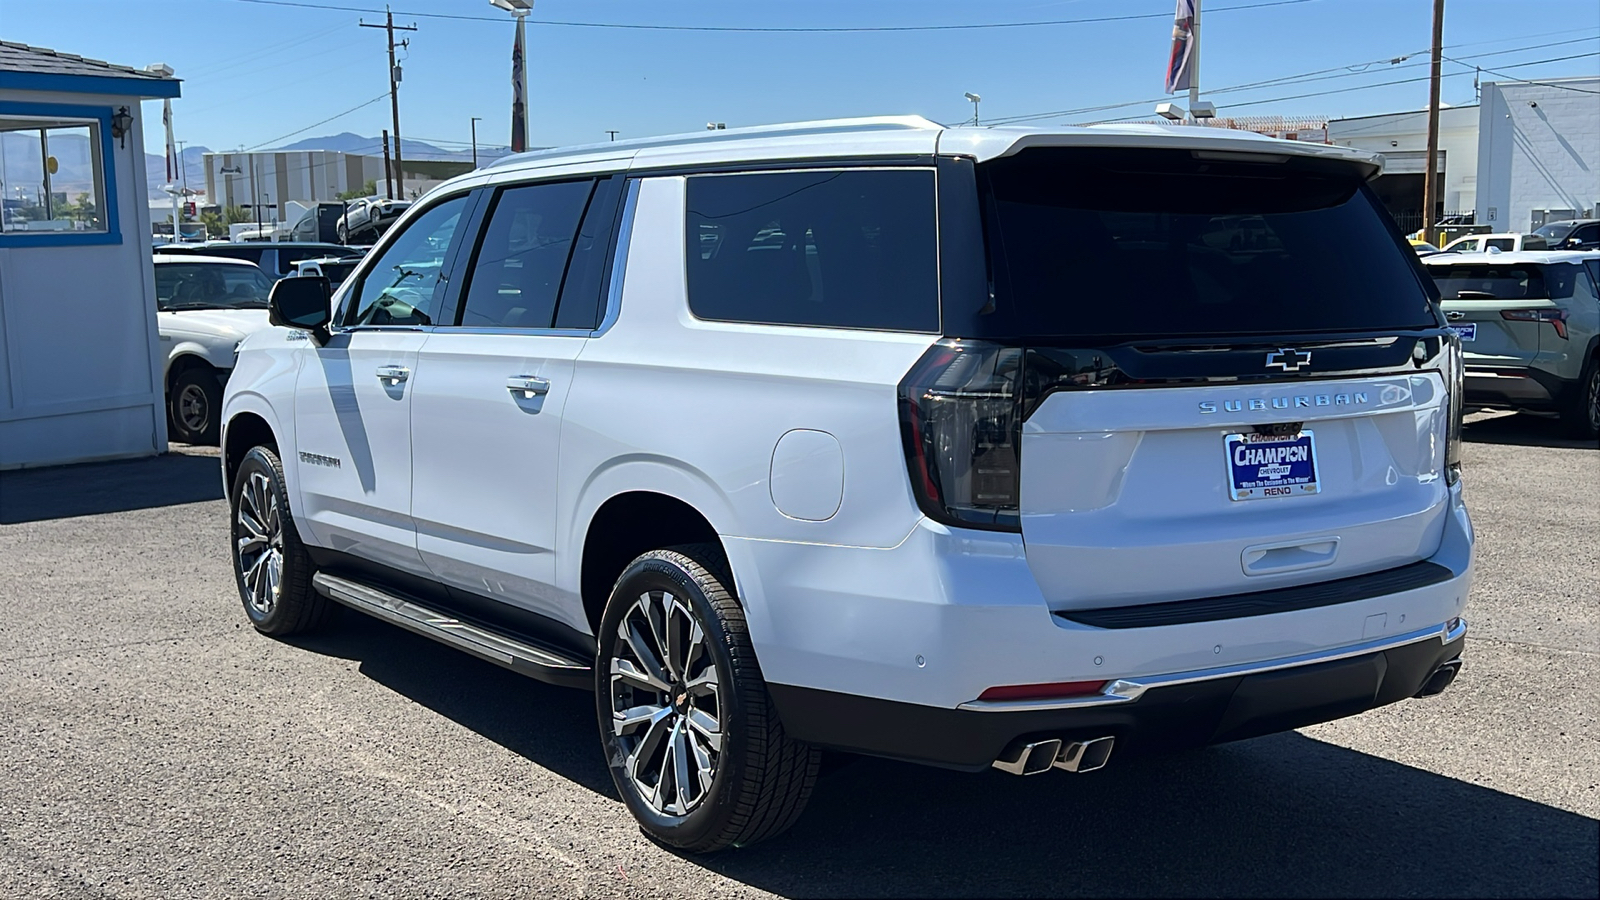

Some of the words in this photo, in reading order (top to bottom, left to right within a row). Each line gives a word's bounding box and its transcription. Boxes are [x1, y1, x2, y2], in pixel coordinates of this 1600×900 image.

[1198, 392, 1369, 414] SUBURBAN
[1260, 466, 1289, 475] CHEVROLET
[1264, 486, 1292, 497] RENO
